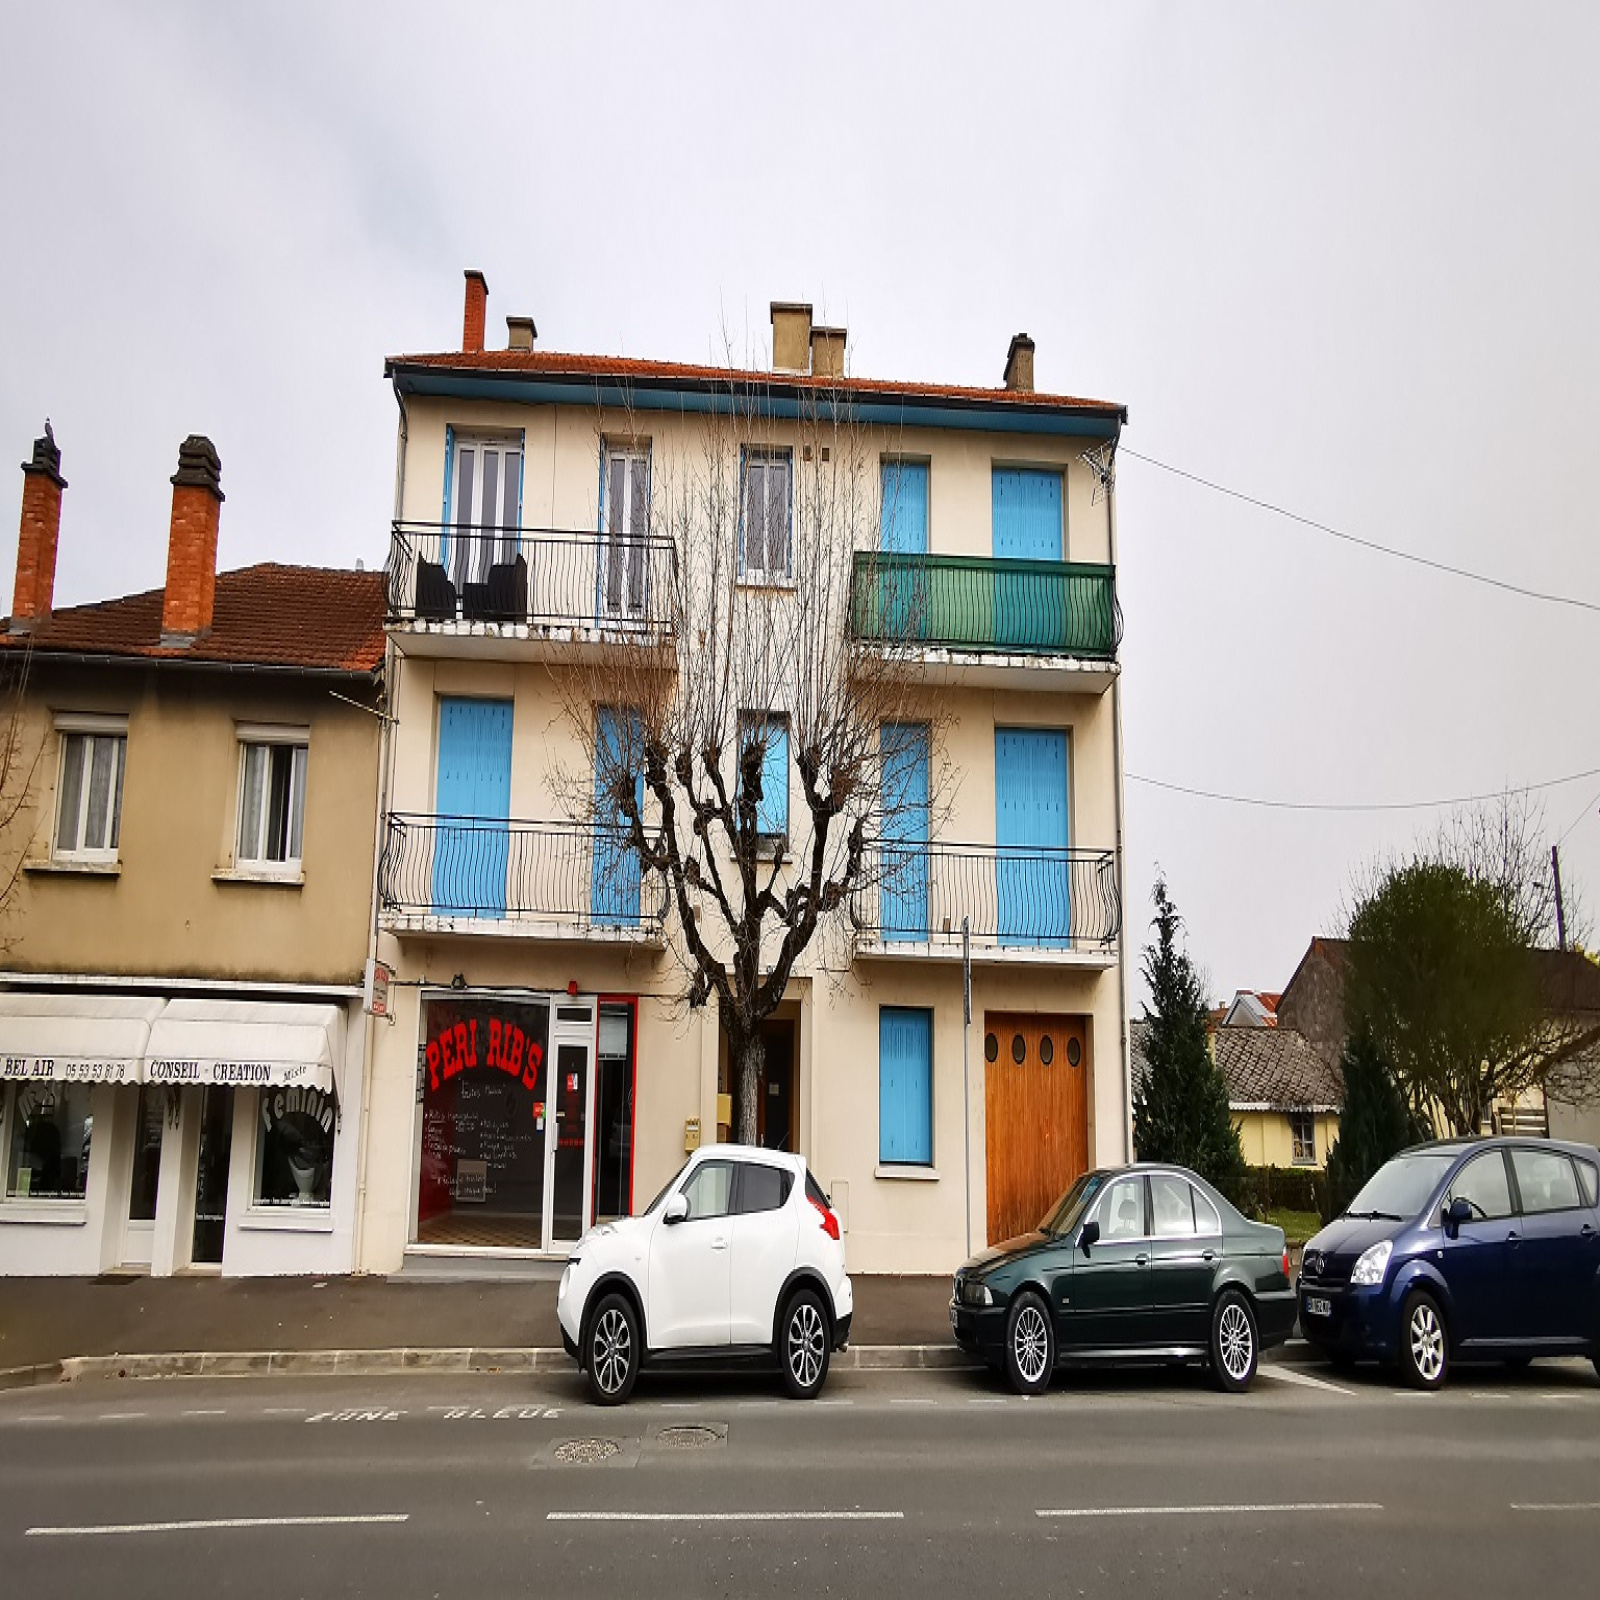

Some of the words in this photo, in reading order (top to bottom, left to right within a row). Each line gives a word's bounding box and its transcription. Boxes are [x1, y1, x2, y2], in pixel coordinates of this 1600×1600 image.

[426, 1018, 478, 1092] PERI
[486, 1017, 544, 1091] RIB'S
[4, 1058, 28, 1077] BEL
[31, 1059, 55, 1077] AIR
[65, 1063, 77, 1079] 05
[78, 1063, 91, 1079] 53
[91, 1063, 104, 1080] 53
[150, 1060, 200, 1080] CONSEIL
[213, 1062, 272, 1082] CREATION
